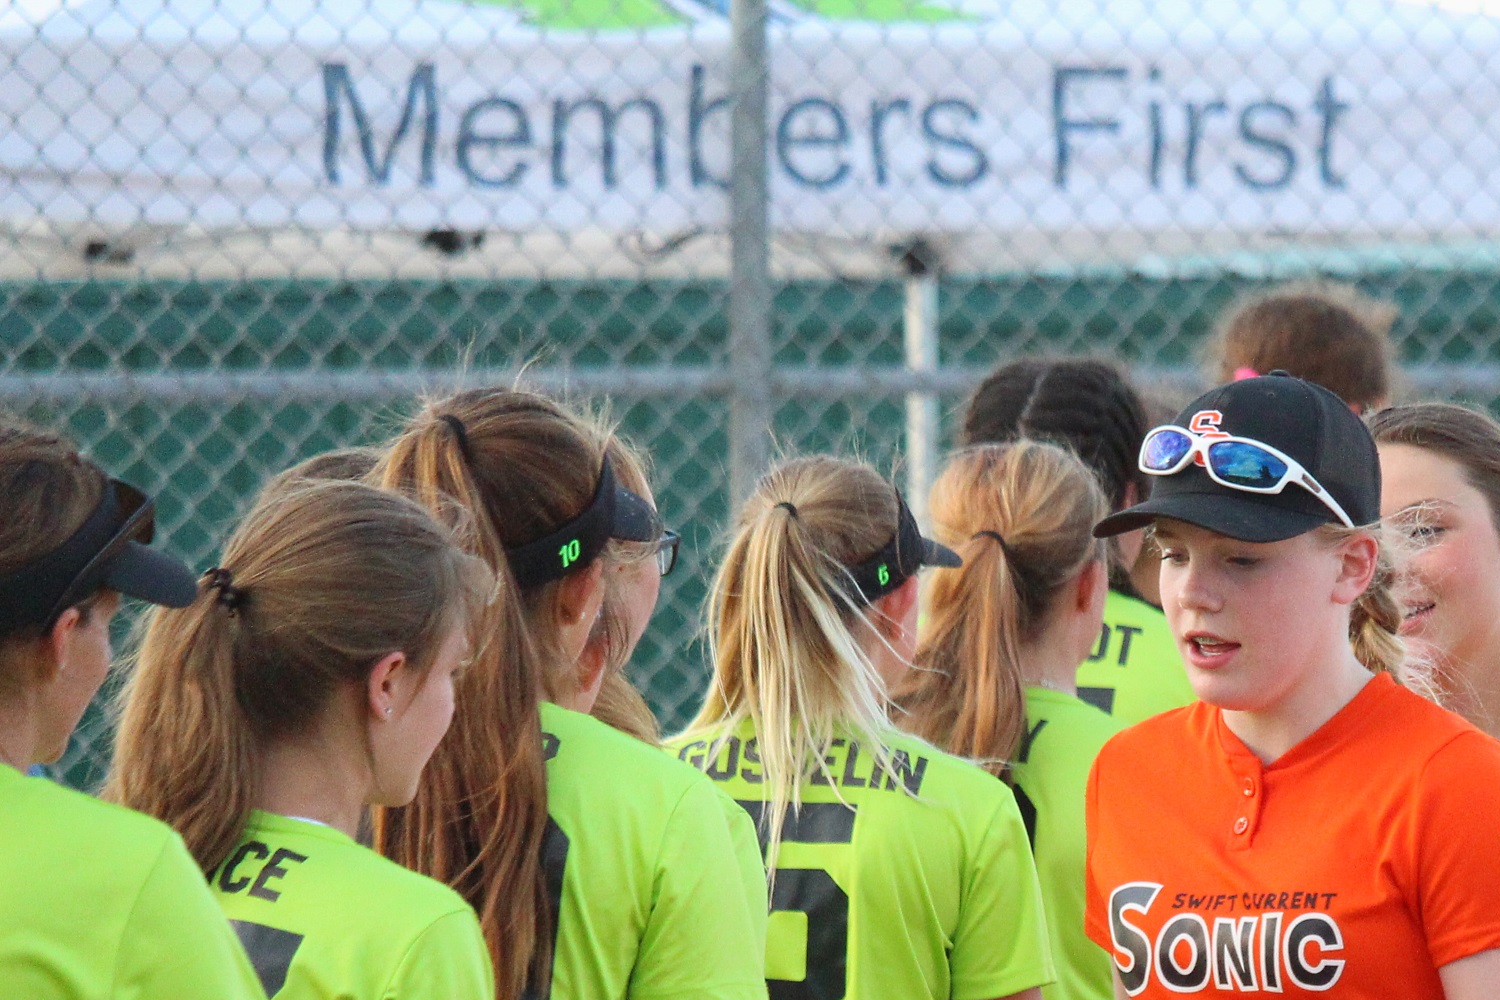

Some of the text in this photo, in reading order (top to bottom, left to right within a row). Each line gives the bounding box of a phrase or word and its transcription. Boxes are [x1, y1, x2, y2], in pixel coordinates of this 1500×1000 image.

[321, 62, 1349, 189] Members First
[558, 539, 580, 568] 10
[680, 736, 928, 796] GOSELIN
[205, 841, 309, 903] CE
[1172, 891, 1338, 912] SWIFT CURRENT
[1108, 881, 1346, 998] SONIC
